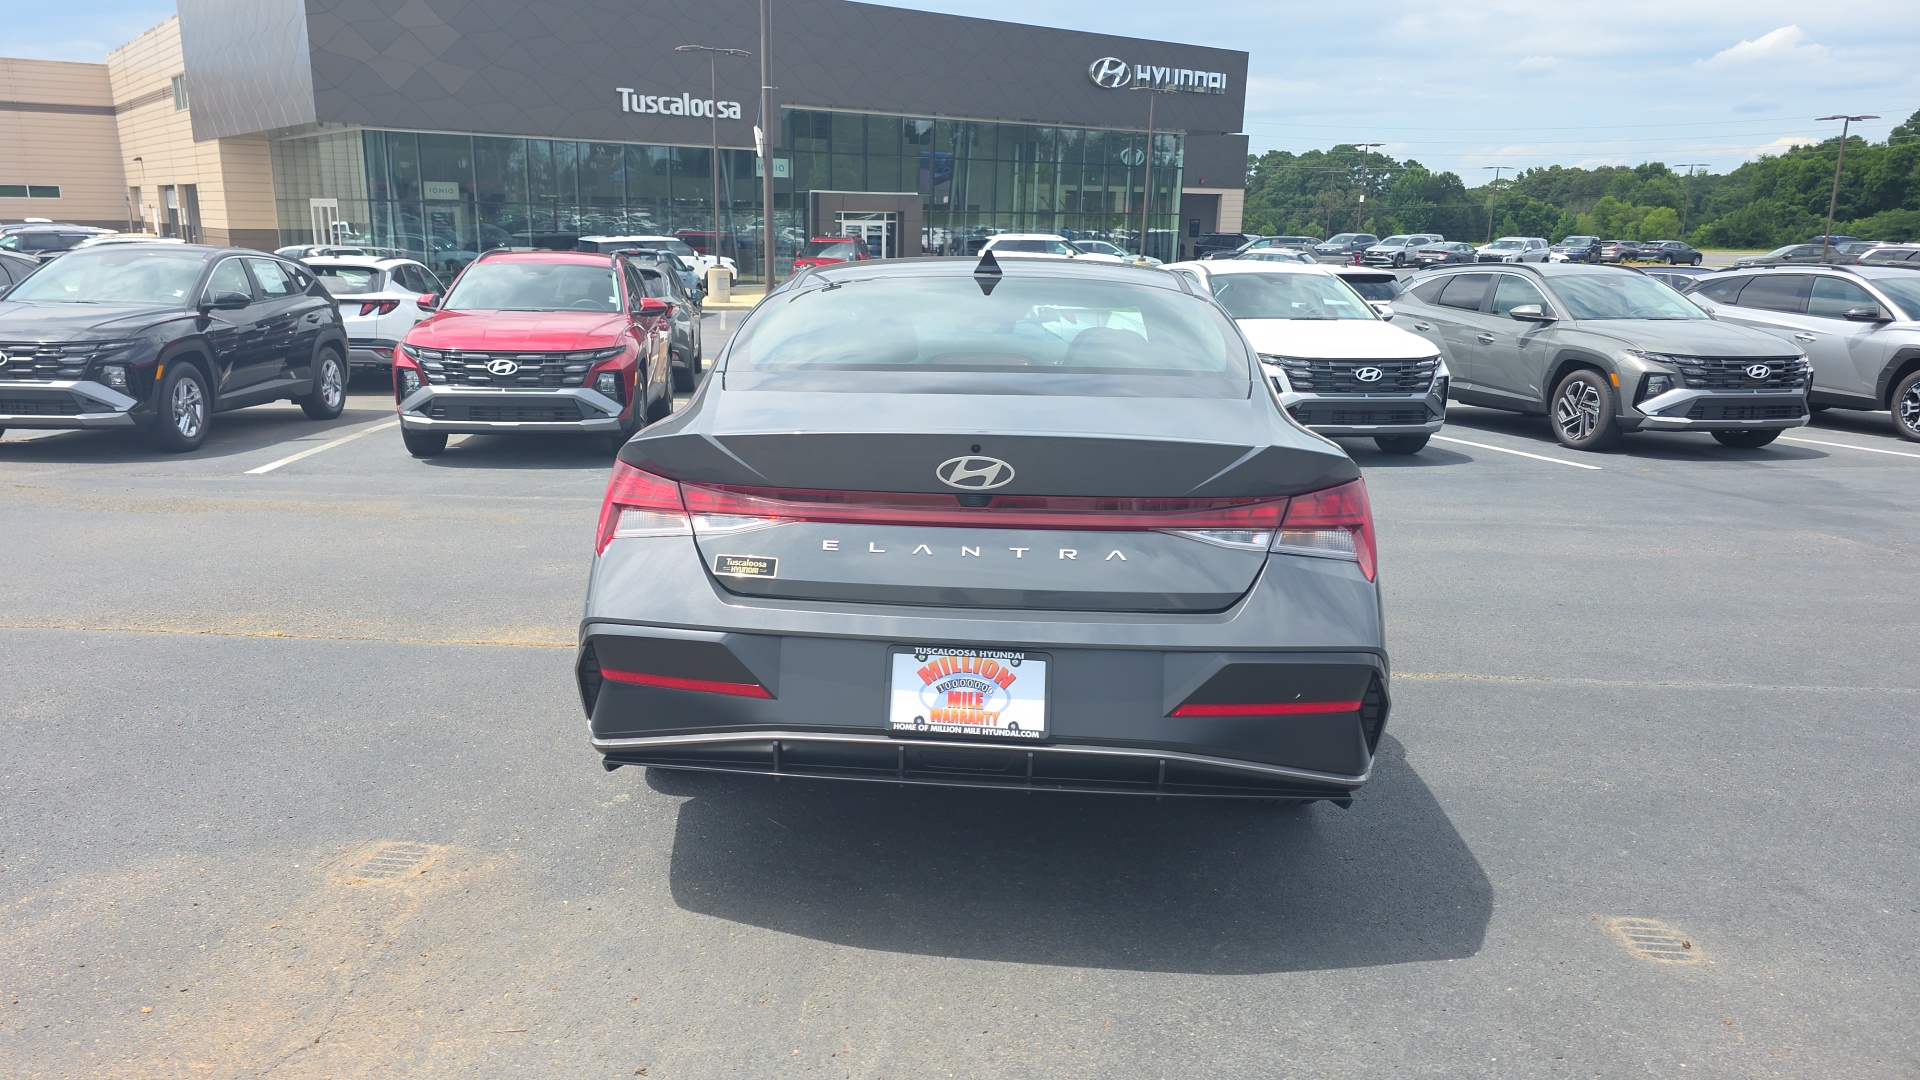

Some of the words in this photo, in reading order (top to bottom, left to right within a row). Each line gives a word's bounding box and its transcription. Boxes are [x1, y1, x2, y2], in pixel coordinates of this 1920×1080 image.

[1133, 65, 1227, 94] HYUNDAI
[616, 87, 741, 120] Tuscaloosa
[757, 164, 785, 172] IIQ
[822, 539, 1127, 562] ELANTRA
[726, 557, 767, 568] Tuscaloosa
[730, 566, 759, 574] HYUNDAI
[914, 647, 977, 657] TUSCALOOSA
[979, 650, 1025, 660] HYUNDAI
[917, 656, 1017, 690] MILLION
[947, 690, 984, 710] MILE
[929, 708, 1000, 726] WARRANTY
[893, 722, 917, 731] HOME
[918, 724, 929, 732] OF
[930, 725, 962, 734] MILLION
[982, 729, 1040, 739] HYUNDAI.COM
